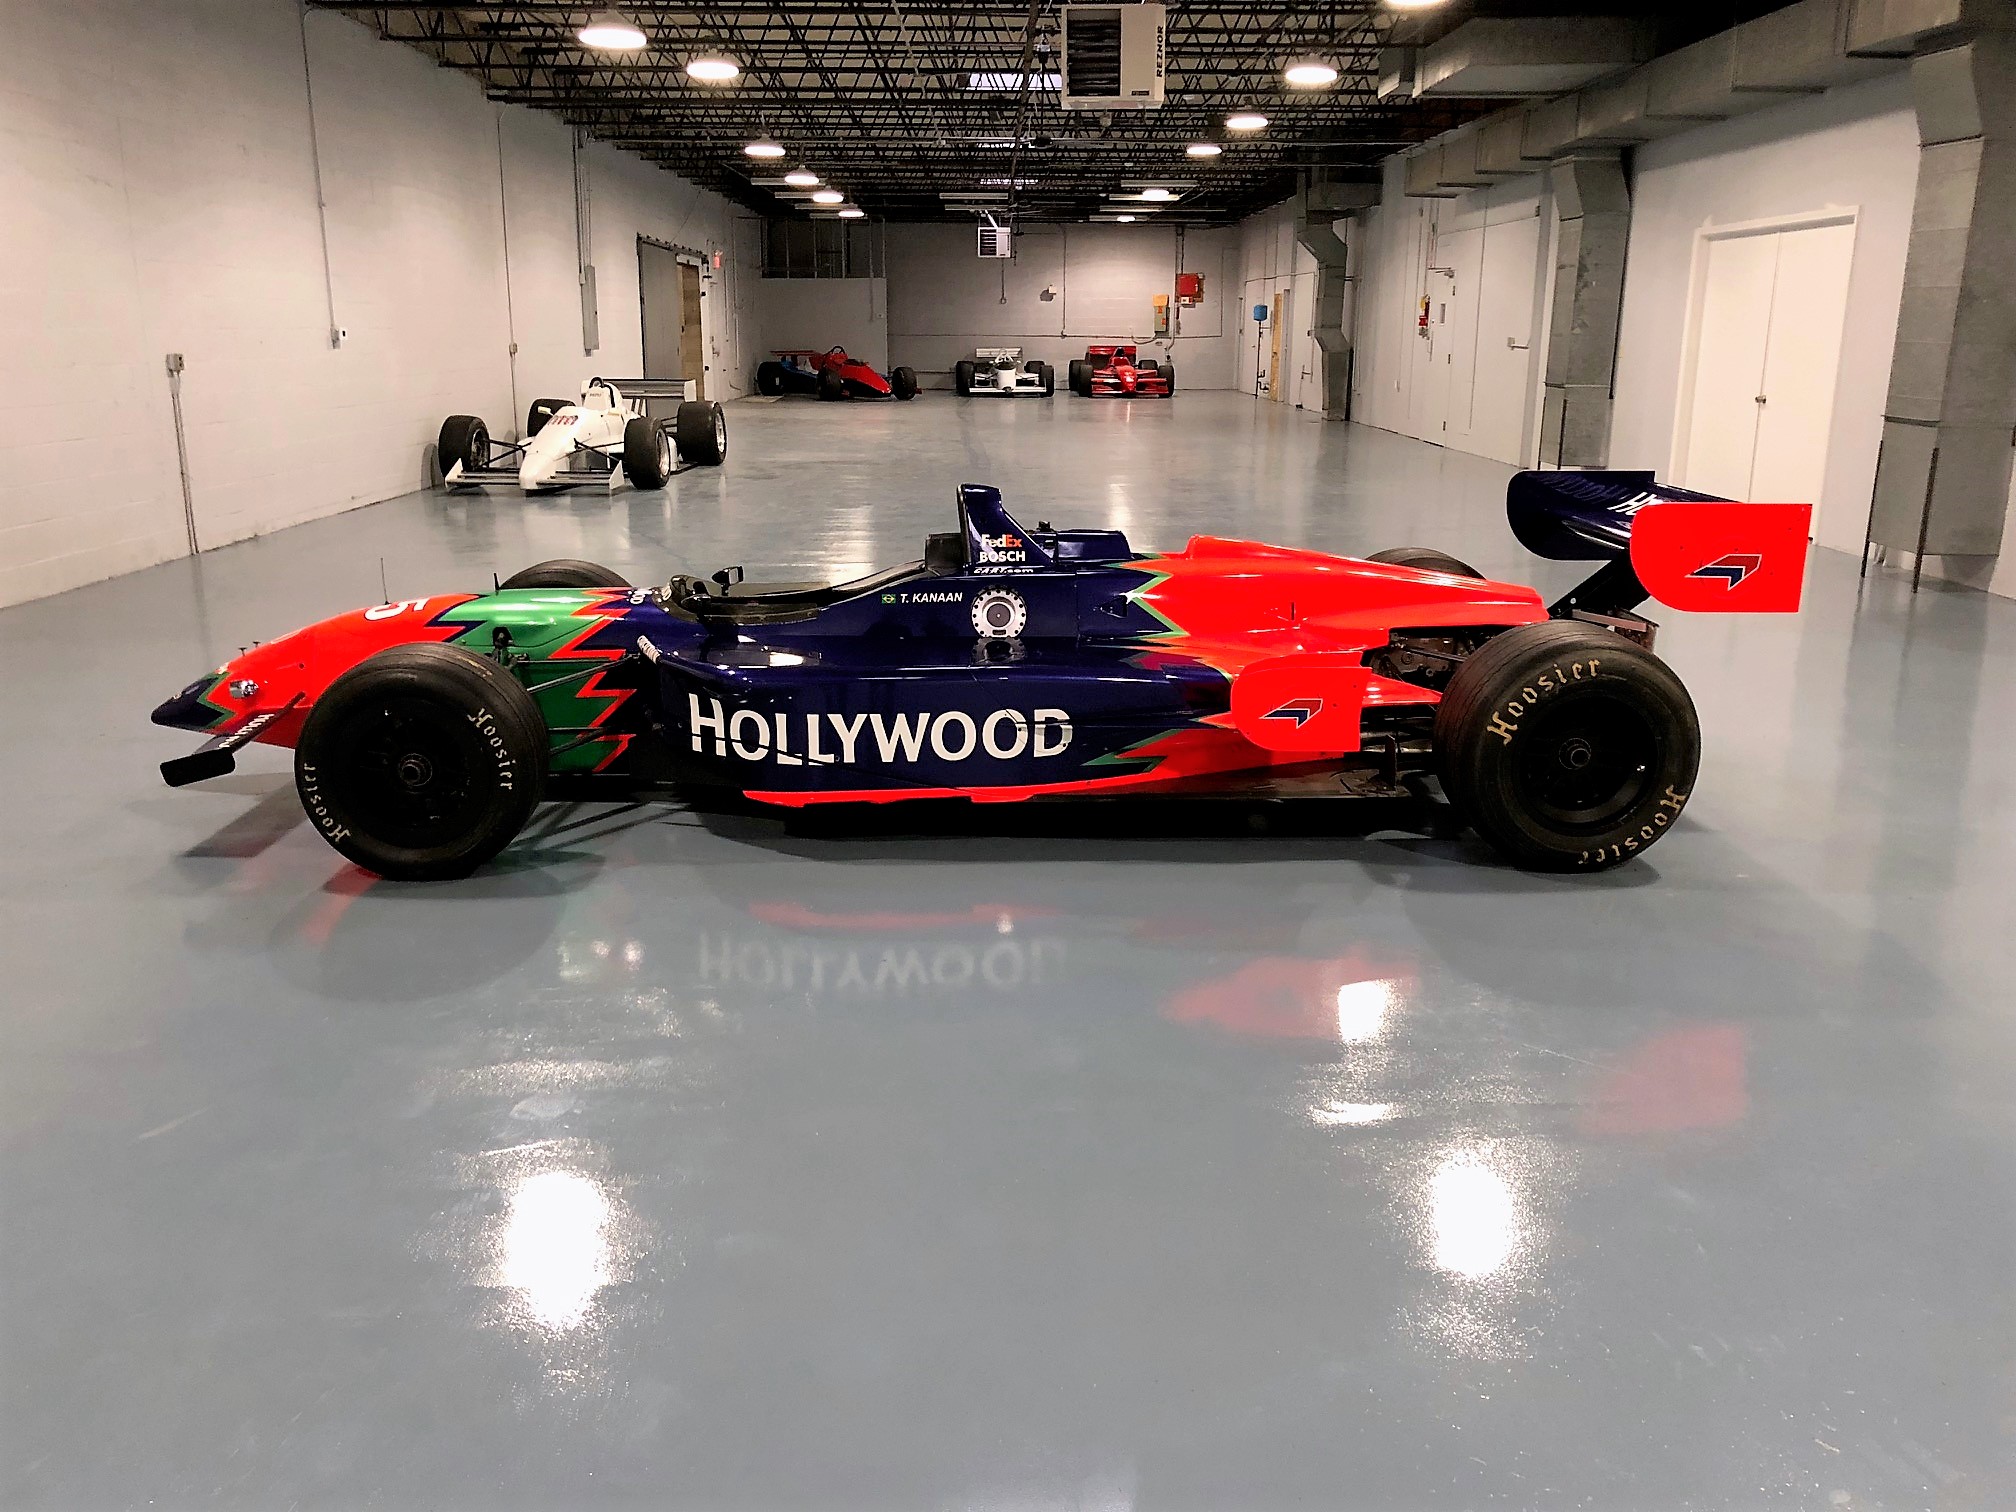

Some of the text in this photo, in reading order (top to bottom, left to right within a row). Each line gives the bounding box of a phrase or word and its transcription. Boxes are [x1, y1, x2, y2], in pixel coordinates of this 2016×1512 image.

[1156, 25, 1164, 78] REZNOR
[979, 550, 1026, 563] BOSCH
[981, 533, 1023, 548] FedEx
[900, 592, 963, 604] T. KANAAN
[688, 693, 1074, 766] HOLLYWOOD
[1486, 658, 1600, 747] Hoosier
[466, 707, 517, 791] Hoosier
[303, 762, 351, 843] Hoosier
[1577, 784, 1686, 865] Hoosier
